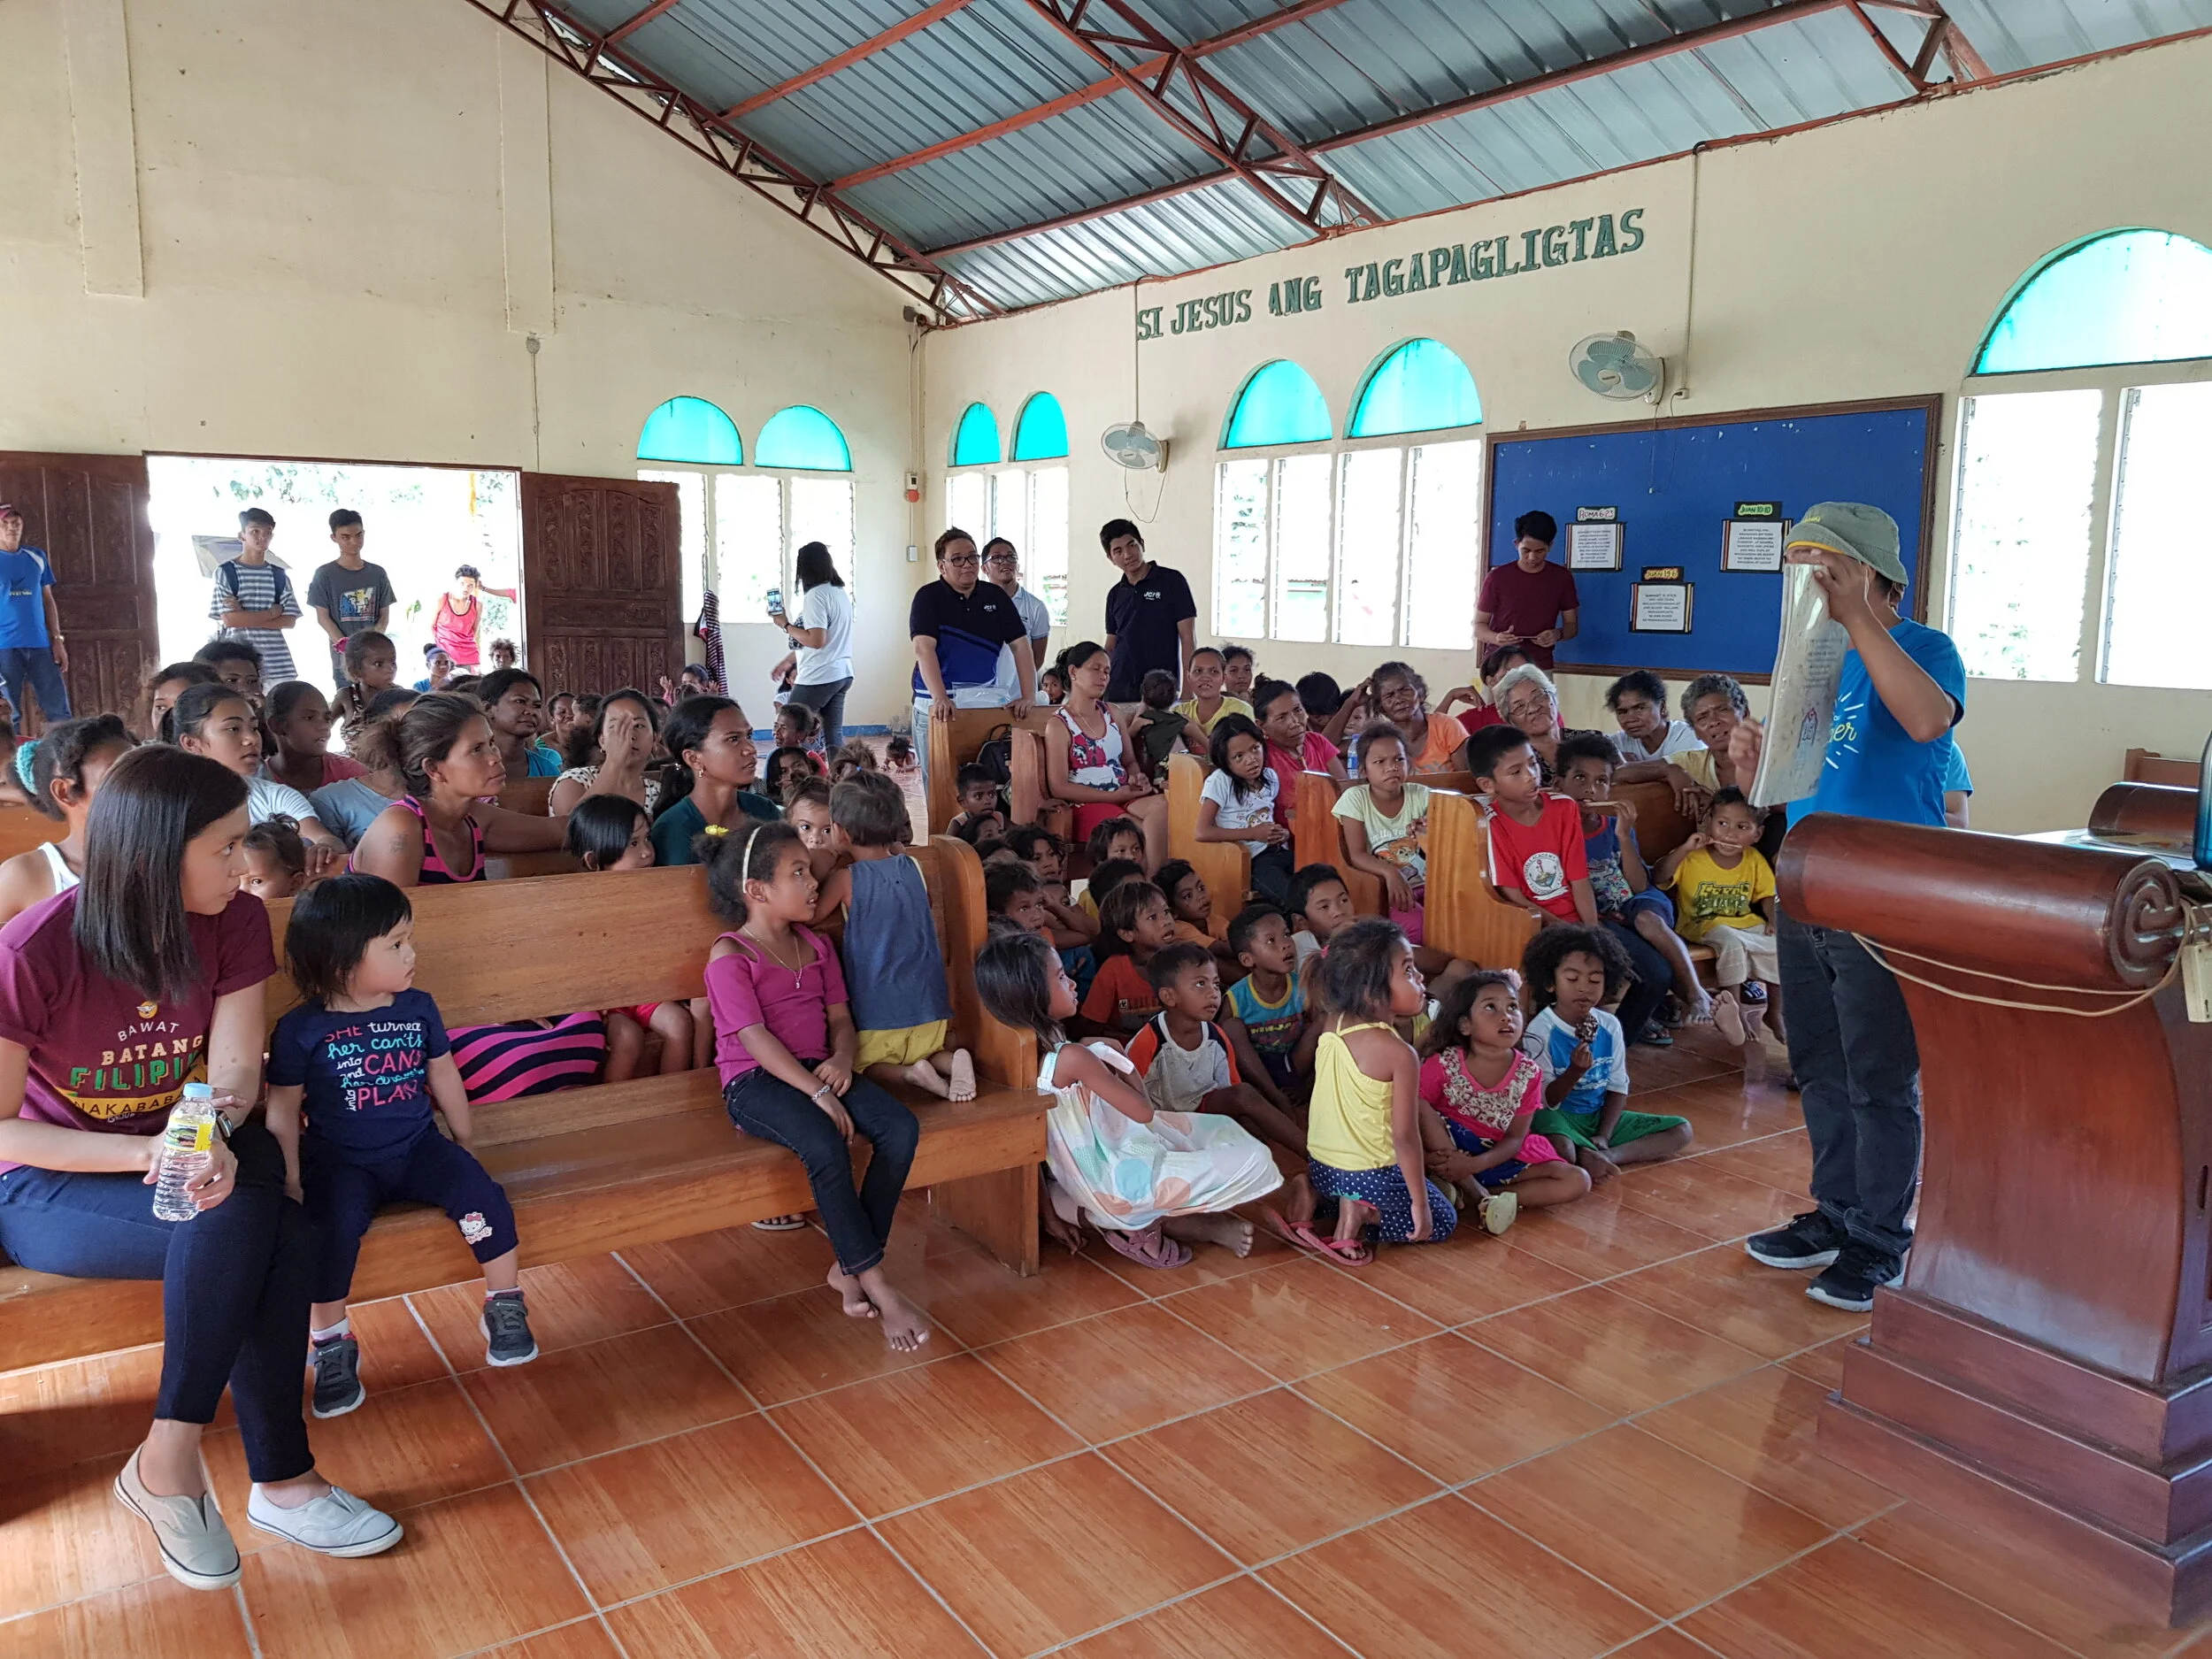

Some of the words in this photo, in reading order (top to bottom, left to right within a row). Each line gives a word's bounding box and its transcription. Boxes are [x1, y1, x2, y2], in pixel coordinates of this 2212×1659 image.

[1137, 307, 1164, 341] SI
[1170, 289, 1252, 335] JESUS
[1268, 276, 1323, 317] ANG
[1345, 208, 1645, 303] TAGAPAGLIGTAS
[1579, 510, 1599, 519] ROMA
[118, 1021, 180, 1041] BAWAT
[101, 1034, 204, 1065] BATANG
[327, 1043, 365, 1059] her
[70, 1049, 200, 1091] FILIPI
[336, 1056, 363, 1070] into
[344, 1089, 357, 1111] into
